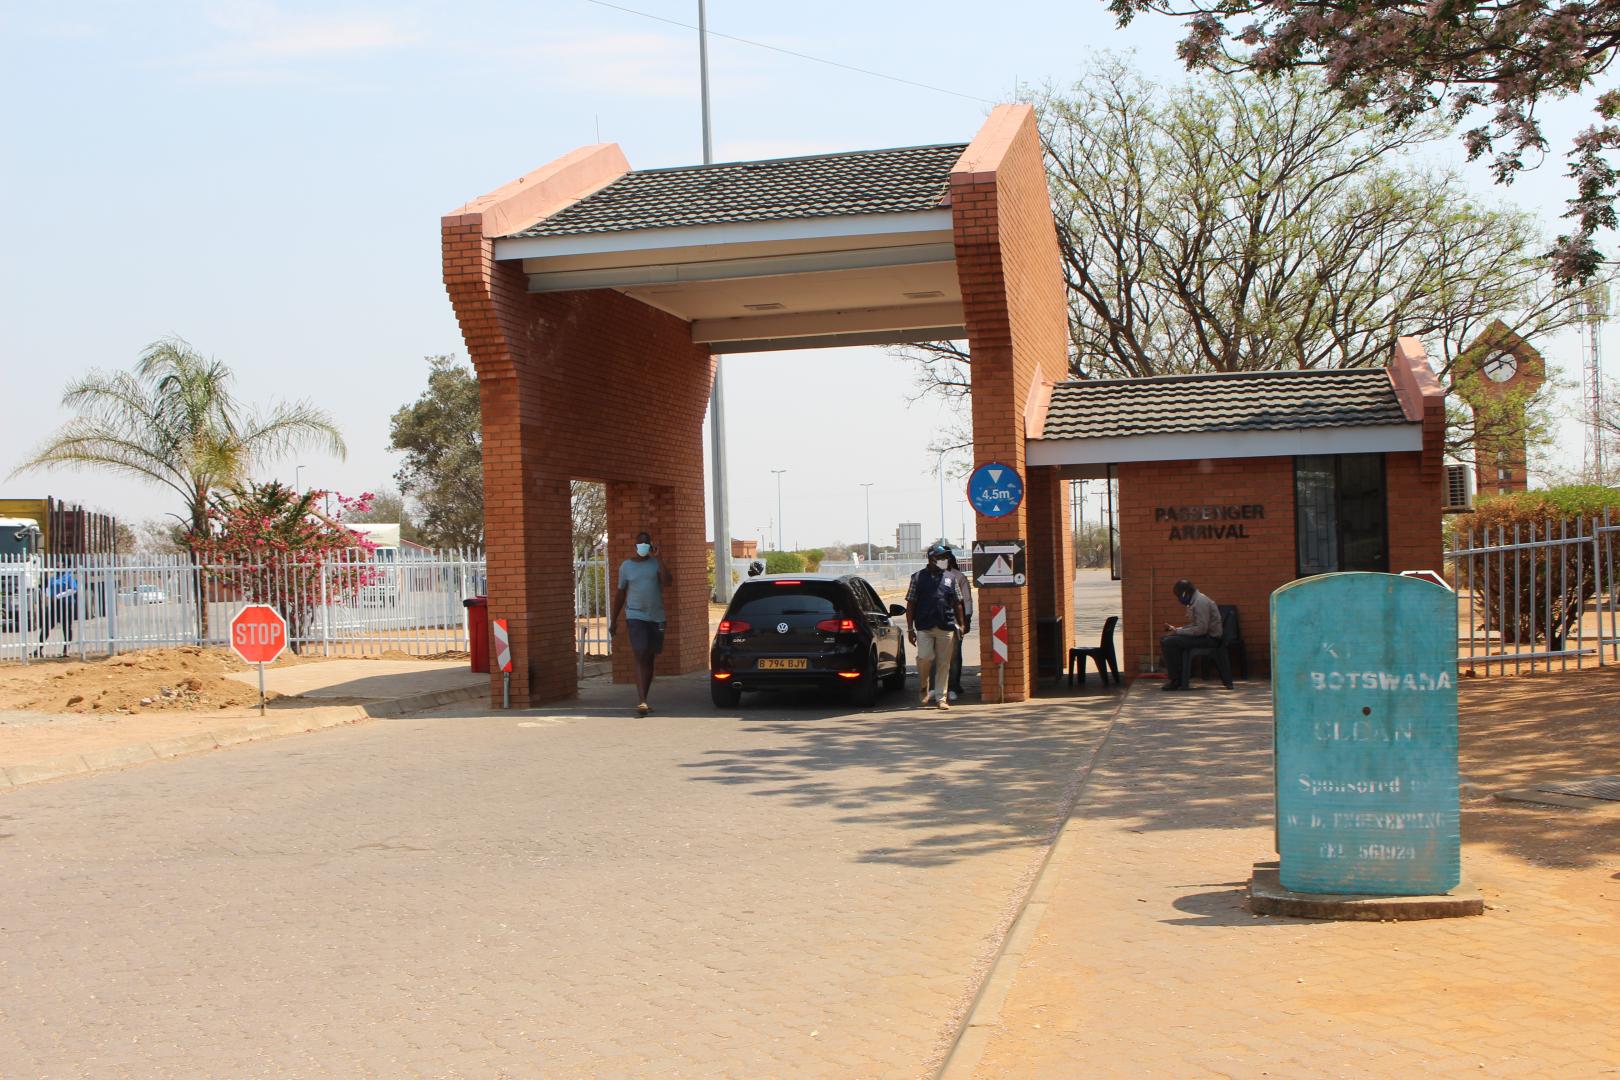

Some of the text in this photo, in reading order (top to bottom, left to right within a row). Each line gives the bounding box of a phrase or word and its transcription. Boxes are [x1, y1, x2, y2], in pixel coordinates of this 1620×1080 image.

[982, 489, 1010, 500] 4.5m
[1155, 504, 1265, 521] PASSENGER
[1169, 524, 1250, 541] ARRIVAL
[236, 623, 281, 645] STOP
[768, 660, 785, 668] 794
[788, 660, 807, 668] BJY
[1310, 671, 1453, 691] BOTSWANA
